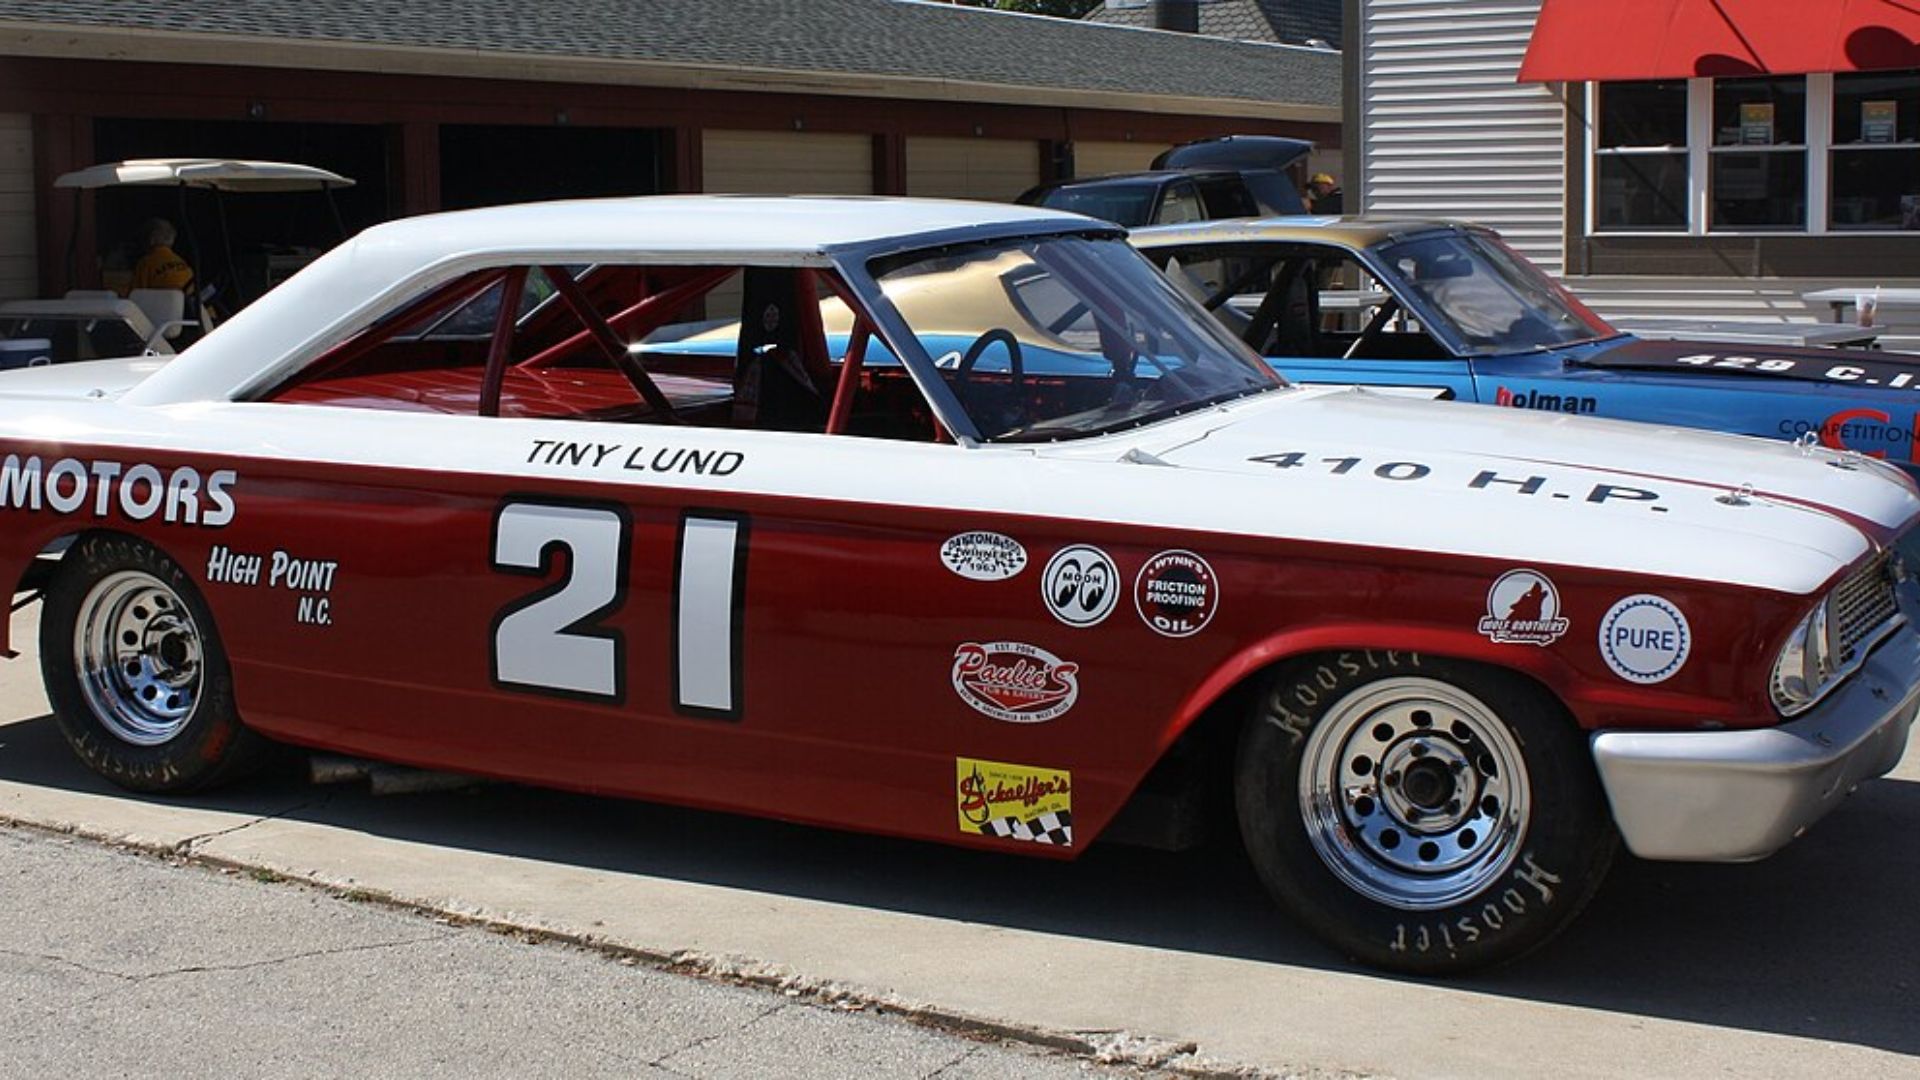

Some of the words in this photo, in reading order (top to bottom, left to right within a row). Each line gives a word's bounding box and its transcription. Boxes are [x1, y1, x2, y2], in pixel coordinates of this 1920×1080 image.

[1677, 354, 1796, 372] 429
[1496, 384, 1597, 414] holman
[526, 440, 622, 467] TINY
[623, 446, 744, 476] LUND
[0, 453, 237, 526] MOTORS
[1247, 451, 1431, 481] 410
[1467, 470, 1669, 512] H.P.
[207, 546, 261, 585] HIGH
[269, 550, 337, 592] POINT
[1062, 571, 1101, 584] MOON
[1146, 591, 1206, 607] PROOFING
[1147, 579, 1207, 596] FRICTION
[297, 596, 332, 625] N.C.
[491, 494, 747, 719] 21
[1153, 615, 1194, 632] OIL
[1615, 627, 1675, 651] PURE
[960, 774, 1070, 810] Schaeffer's
[1389, 850, 1562, 959] Hoosier
